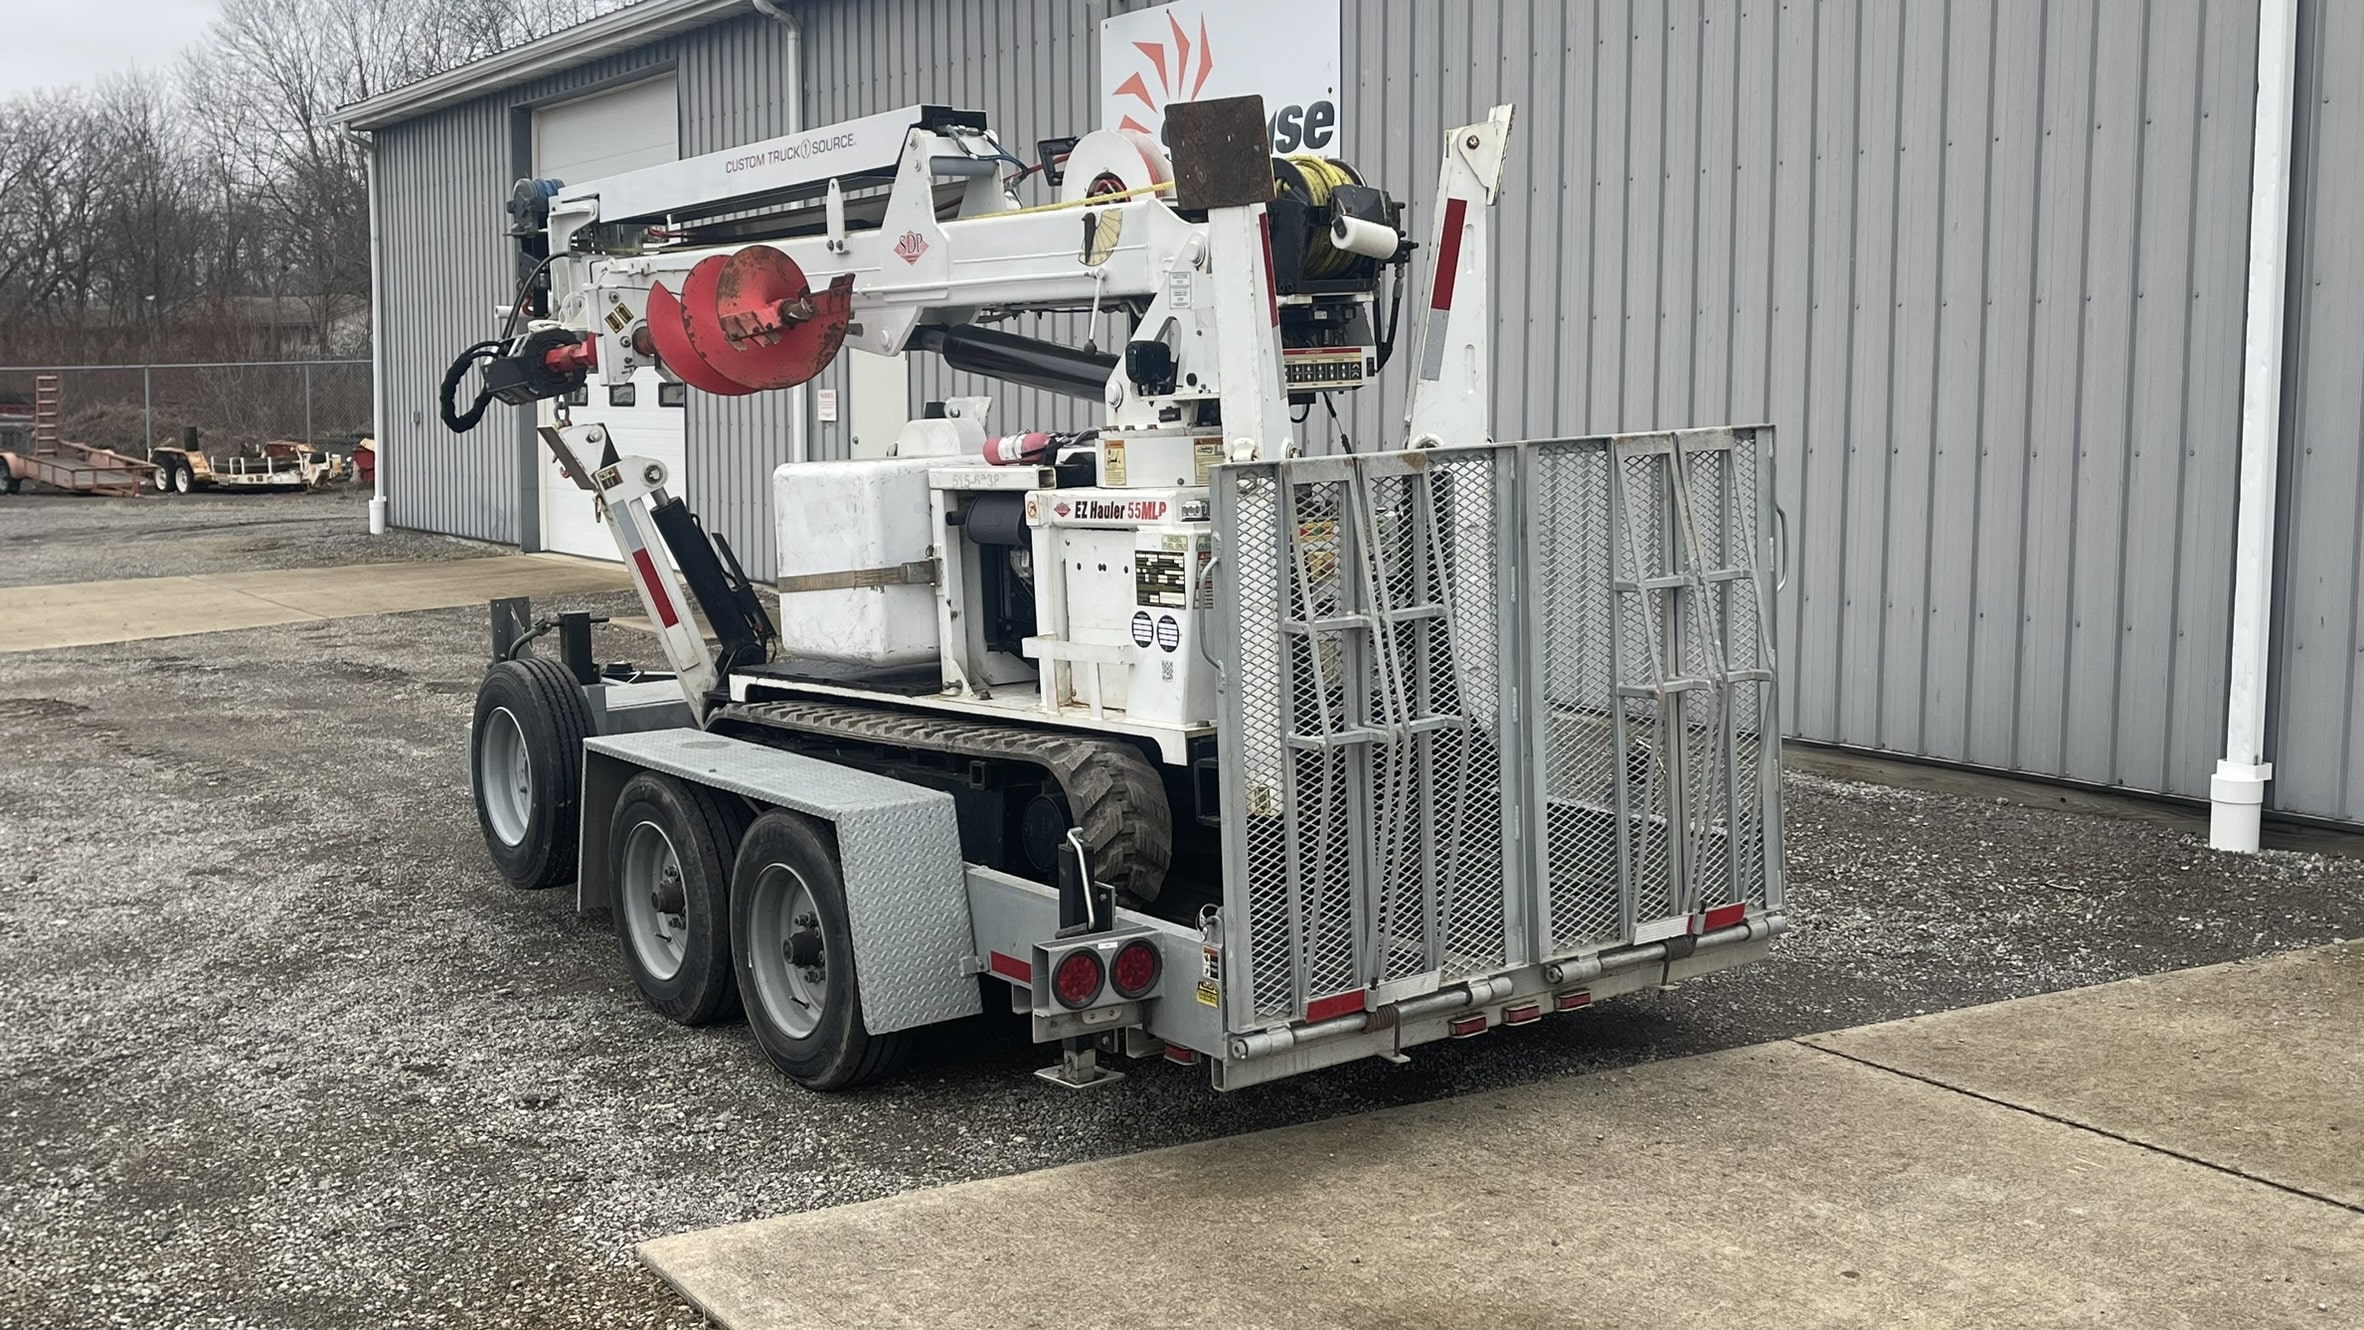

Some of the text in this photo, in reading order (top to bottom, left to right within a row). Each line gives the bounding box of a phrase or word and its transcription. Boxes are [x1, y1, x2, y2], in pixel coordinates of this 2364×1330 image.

[725, 153, 766, 174] CUSTOM
[768, 144, 801, 165] TRUCK
[811, 133, 855, 155] SOURCE
[898, 232, 923, 255] SDP
[1074, 500, 1088, 519] EZ
[1089, 500, 1126, 519] Hauler
[1127, 501, 1167, 520] 55MLP
